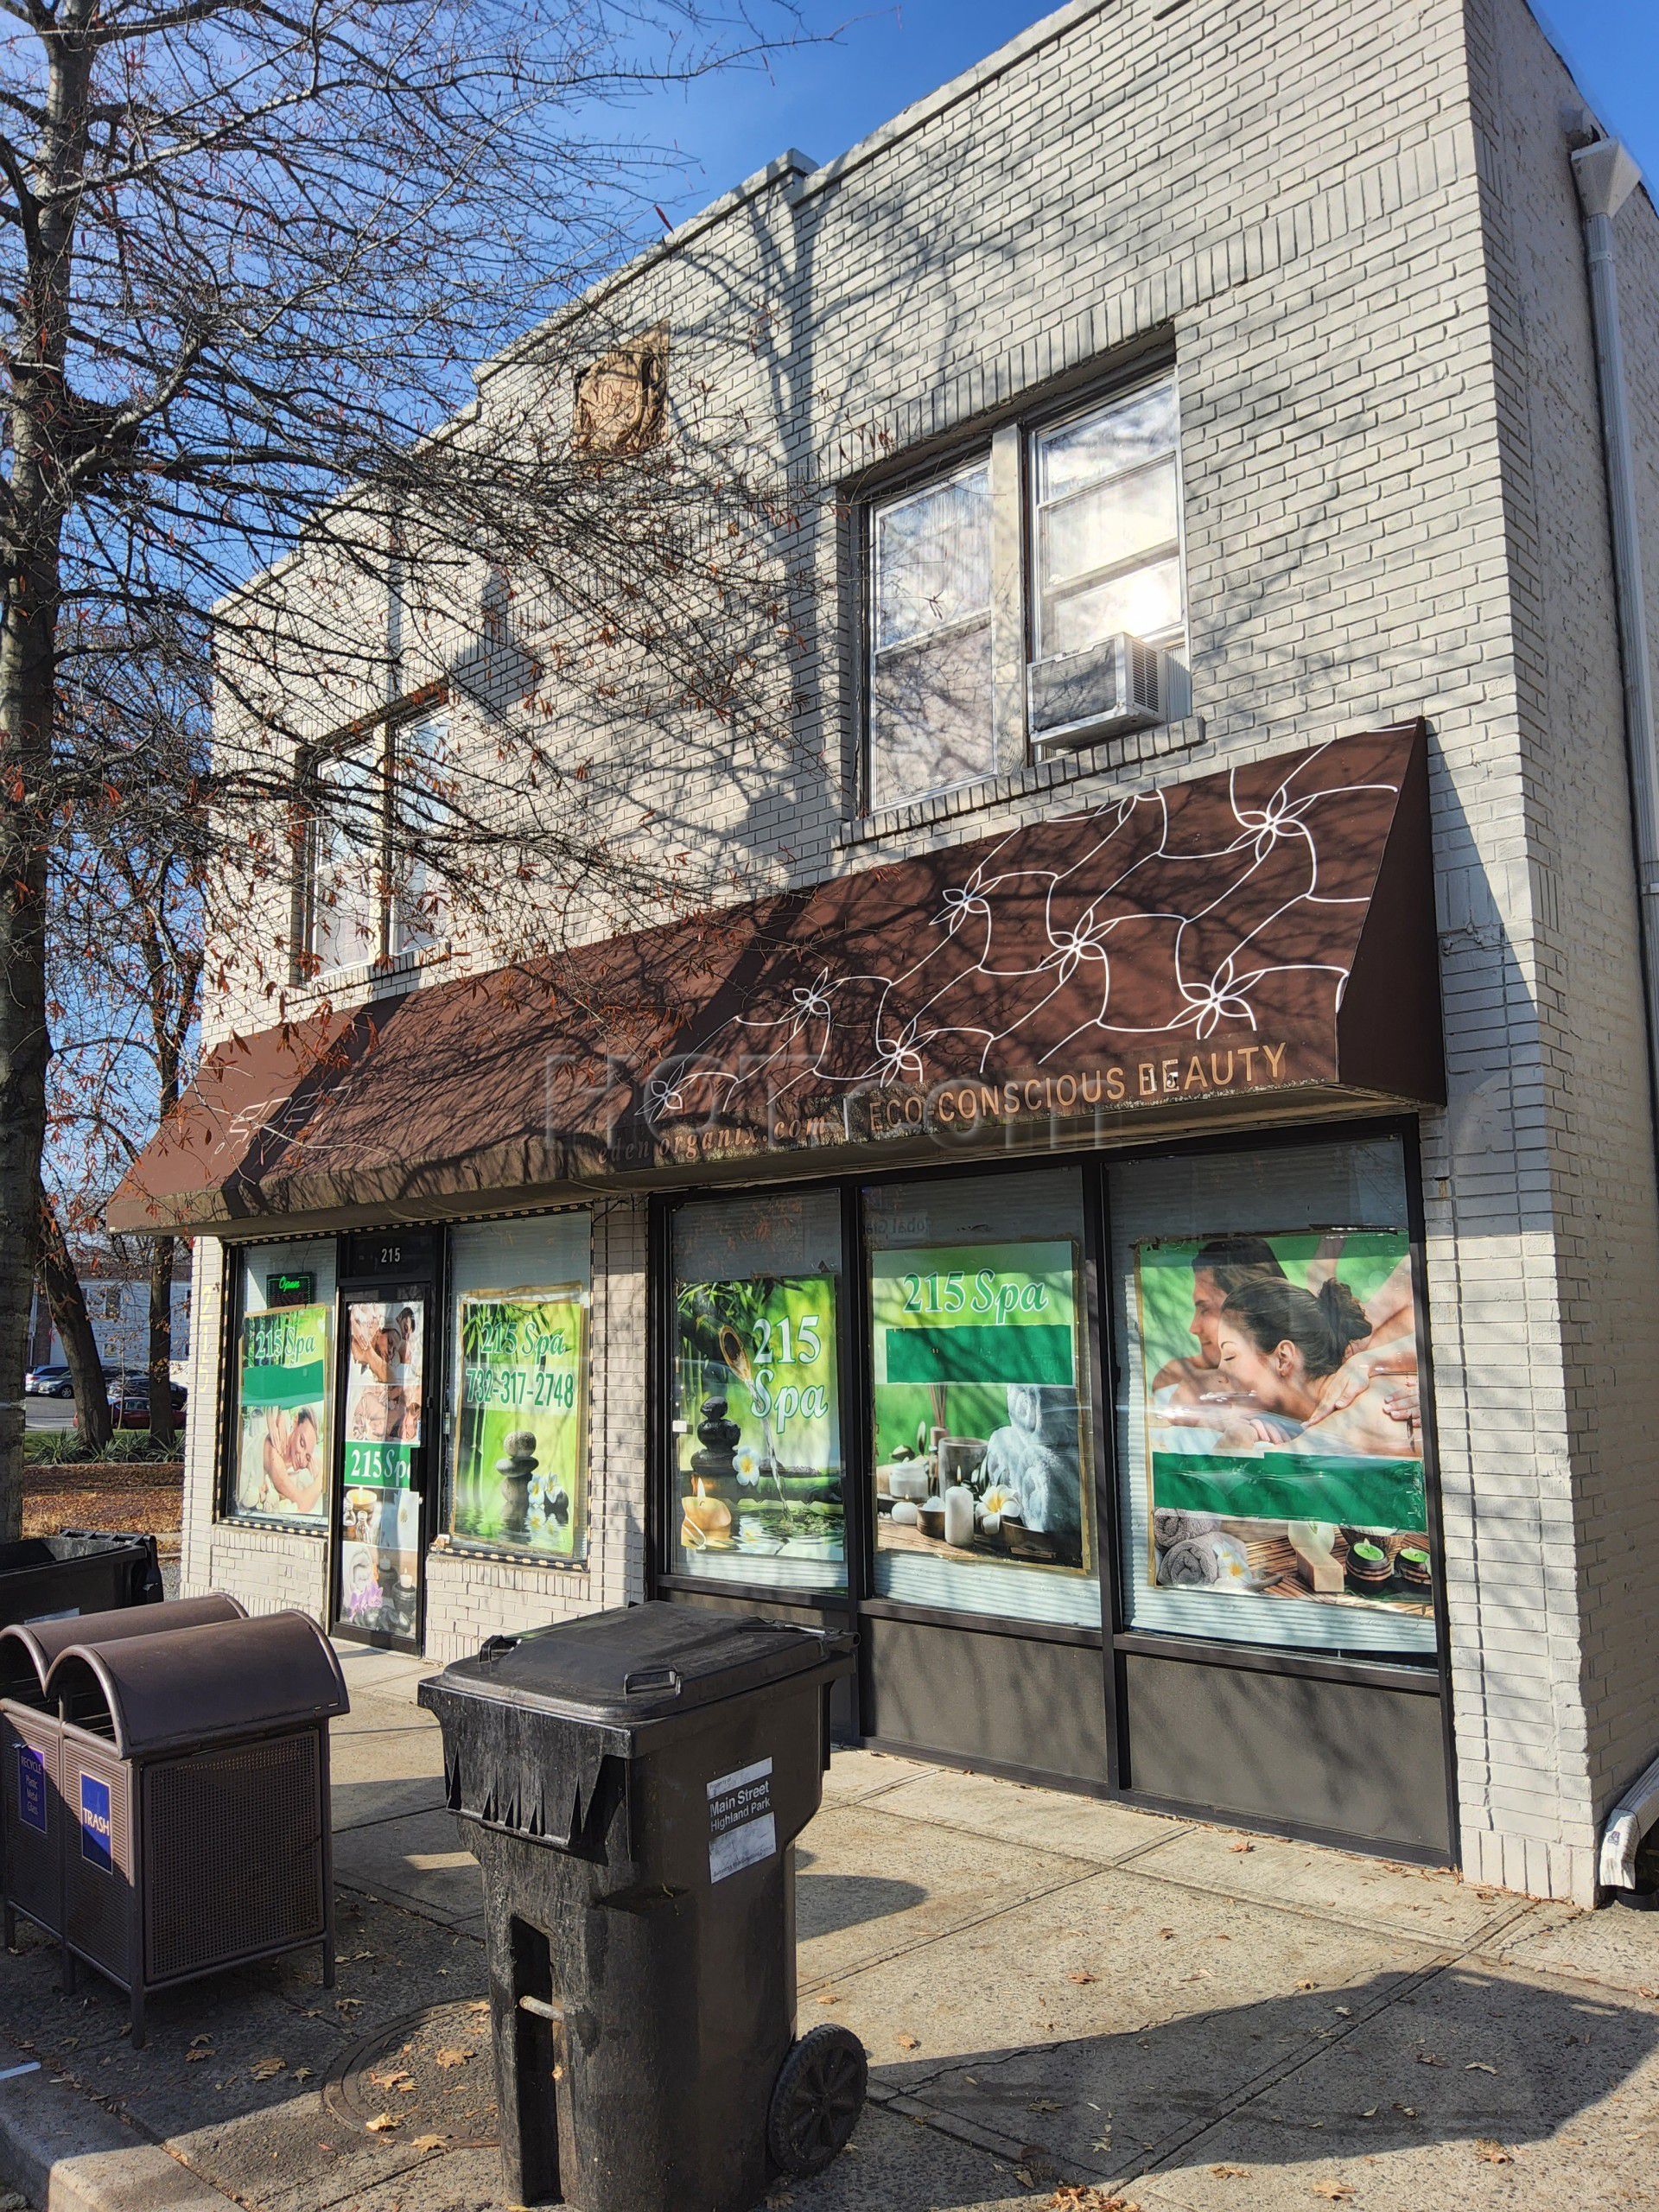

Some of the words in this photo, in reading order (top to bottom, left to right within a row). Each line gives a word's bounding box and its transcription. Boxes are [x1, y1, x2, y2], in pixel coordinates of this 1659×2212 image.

[870, 1066, 1125, 1130] ECO-CONSCIOUS
[1138, 1041, 1286, 1096] BEAUTY
[380, 1247, 401, 1263] 215
[278, 1275, 301, 1293] Open
[903, 1269, 966, 1314] 215
[971, 1267, 1050, 1325] Spa
[255, 1328, 283, 1359] 215
[284, 1326, 316, 1363] Spa
[480, 1320, 518, 1355] 215
[521, 1321, 567, 1365] Spa
[752, 1314, 823, 1366] 215
[466, 1368, 575, 1409] 732-317-2748
[750, 1369, 829, 1435] Spa
[351, 1449, 382, 1478] 215
[384, 1449, 411, 1487] Sp
[20, 1756, 41, 1775] RECYCLE
[709, 1796, 735, 1818] Main
[737, 1781, 770, 1805] Street
[710, 1806, 749, 1833] Highland
[751, 1796, 771, 1815] Park
[83, 1807, 111, 1837] TRASH
